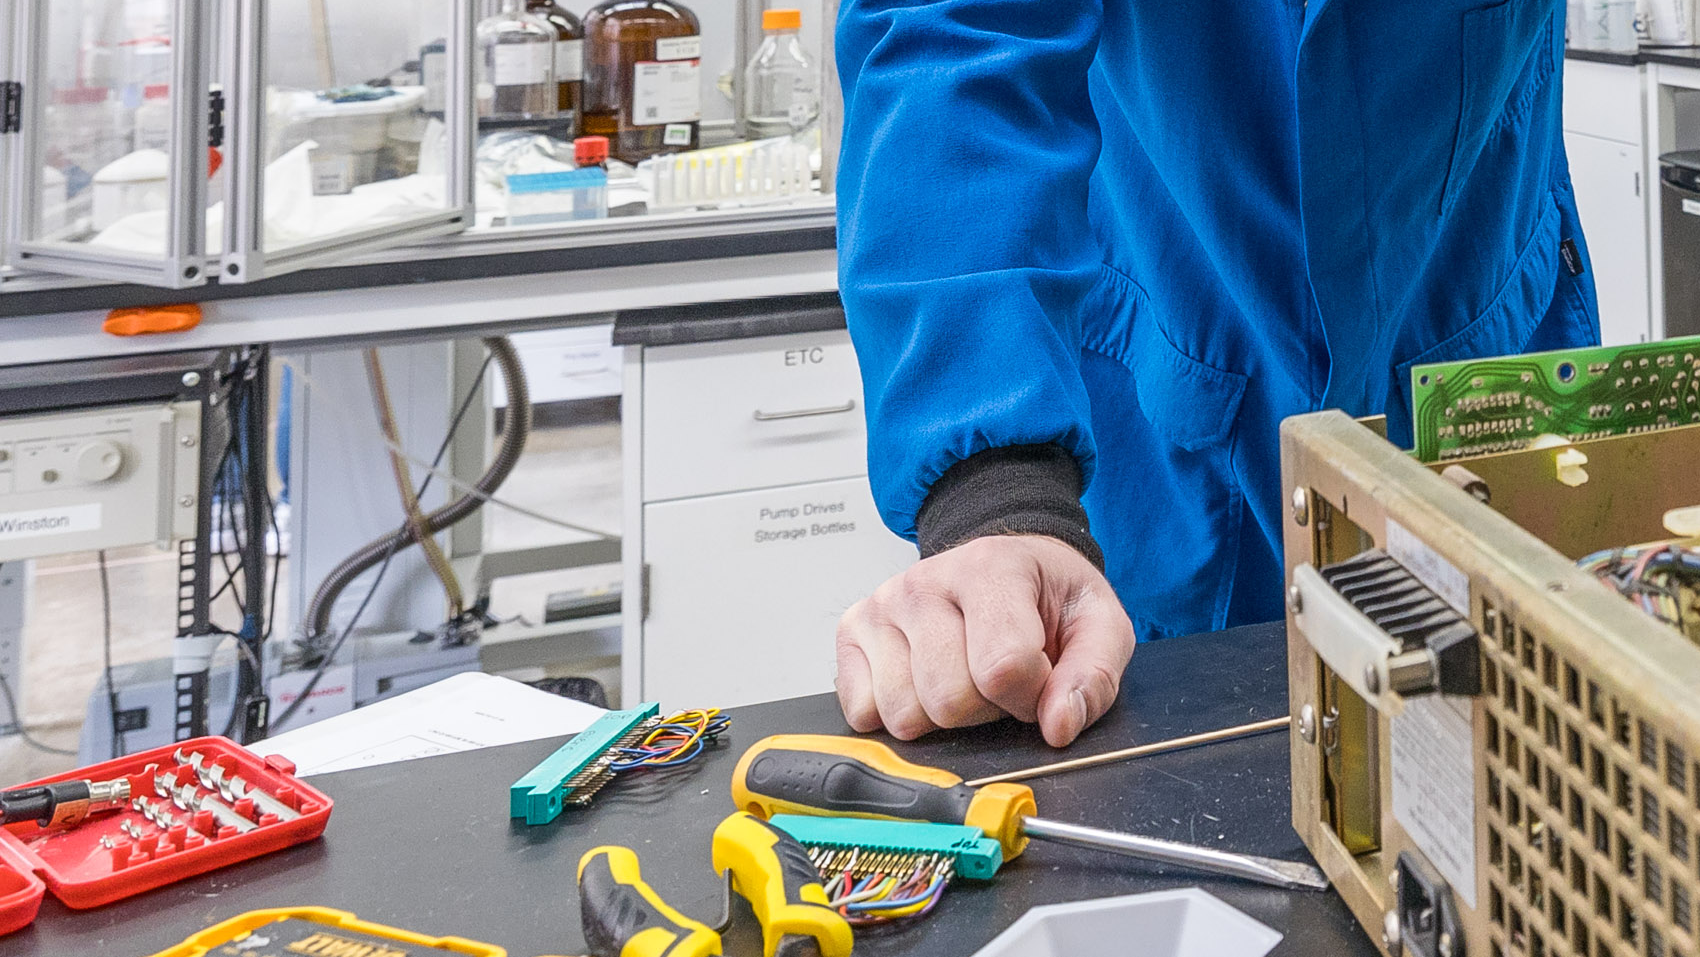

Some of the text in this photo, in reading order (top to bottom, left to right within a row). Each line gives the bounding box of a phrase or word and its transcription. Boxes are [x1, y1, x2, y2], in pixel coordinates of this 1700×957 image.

[785, 347, 824, 366] ETC
[760, 503, 845, 520] Pump Drives
[755, 522, 856, 543] Storage Bottles
